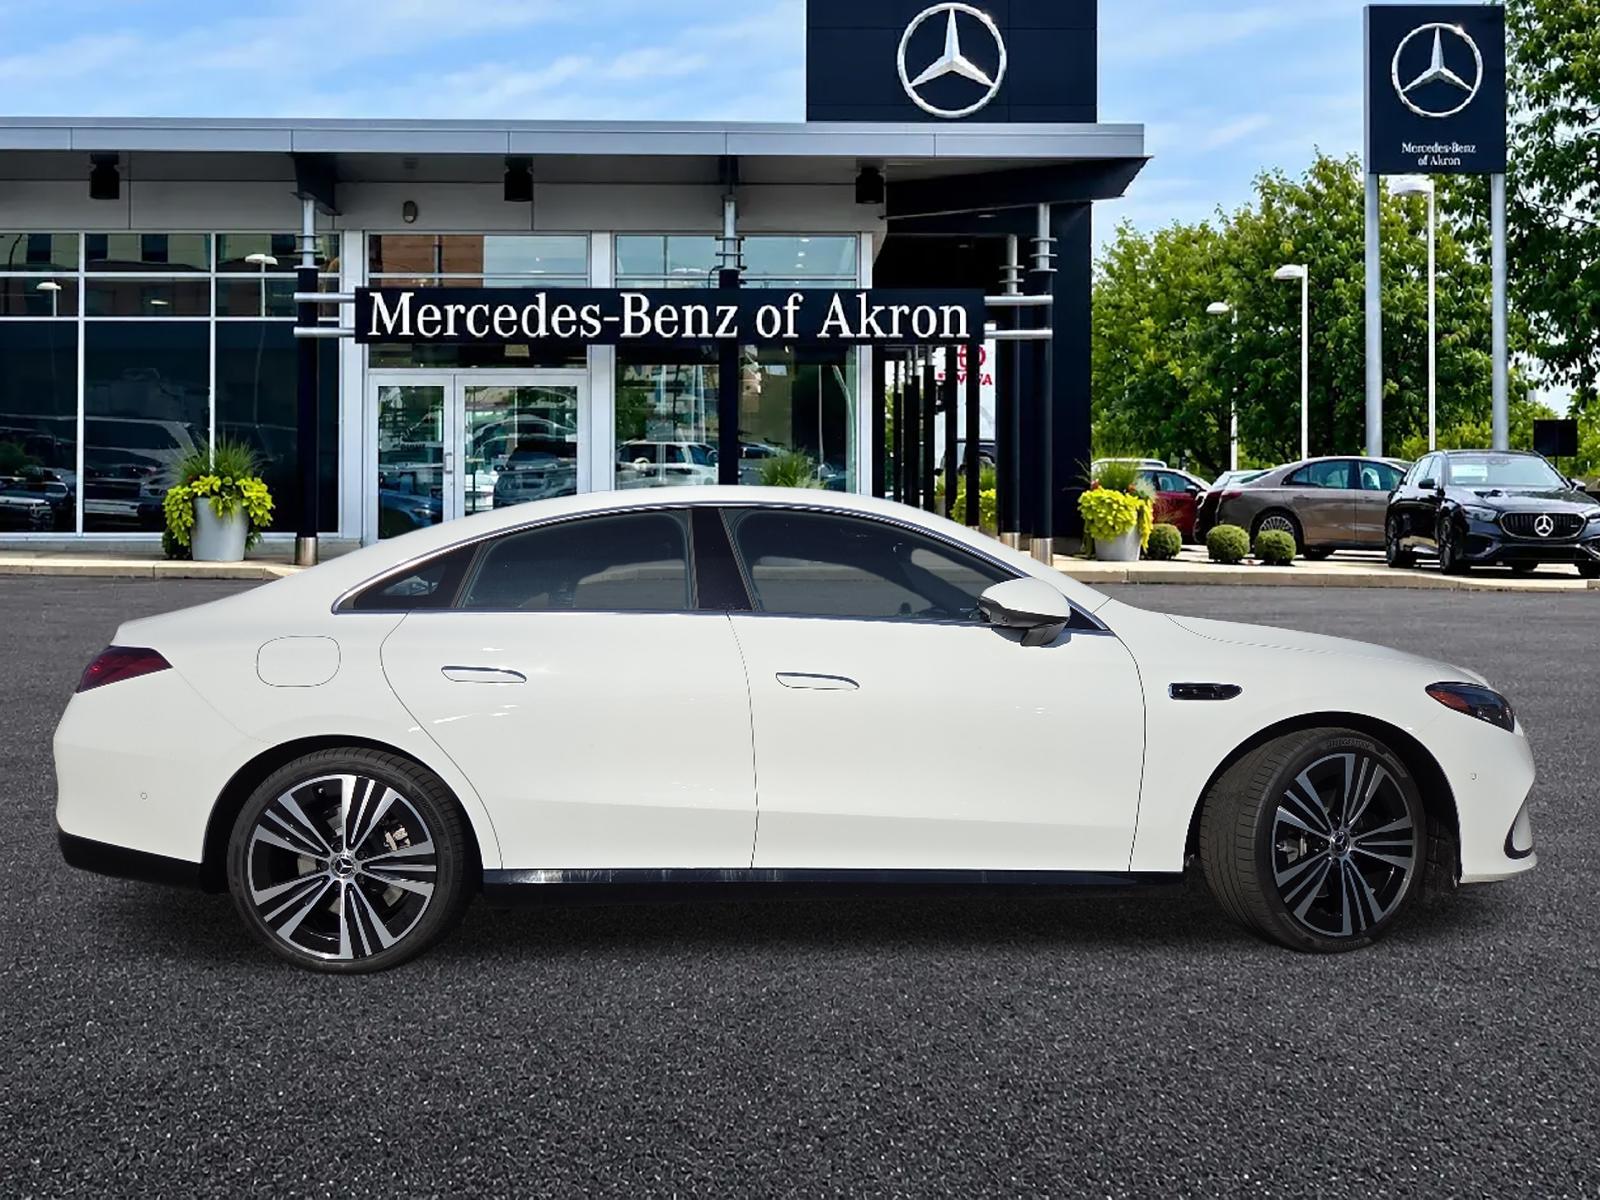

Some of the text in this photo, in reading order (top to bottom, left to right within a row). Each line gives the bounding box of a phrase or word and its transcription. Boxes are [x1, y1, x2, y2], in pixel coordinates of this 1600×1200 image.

[1401, 141, 1476, 154] Mercedes-Benz
[1417, 154, 1461, 166] of Akron
[367, 291, 971, 339] Mercedes-Benz of Akron
